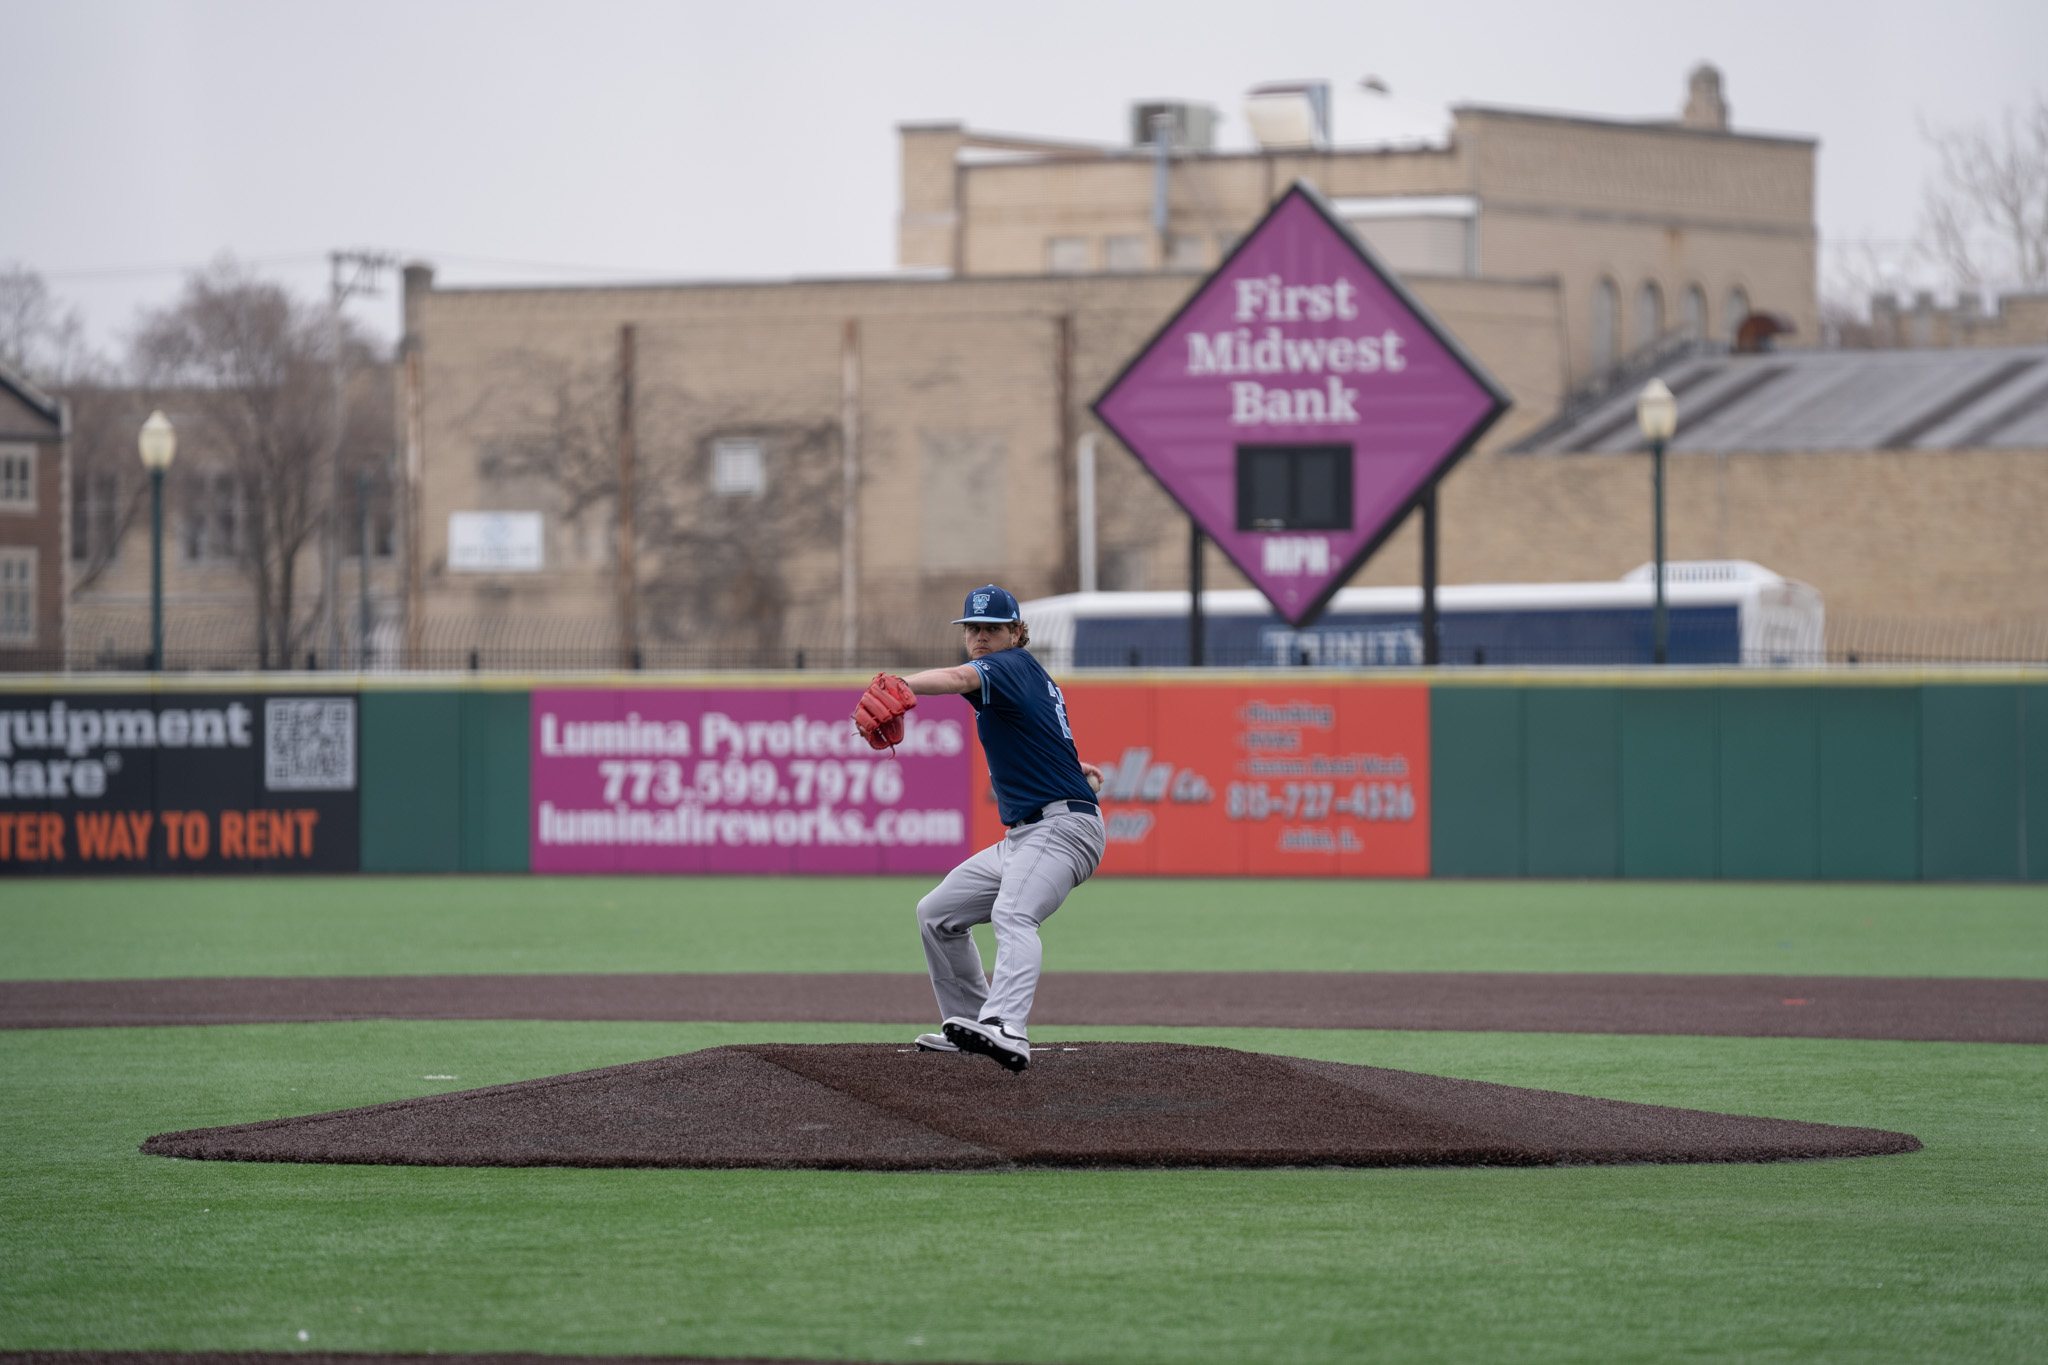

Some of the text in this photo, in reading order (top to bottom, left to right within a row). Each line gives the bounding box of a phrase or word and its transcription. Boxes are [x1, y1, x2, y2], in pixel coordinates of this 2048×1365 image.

[1233, 274, 1358, 322] First
[1185, 328, 1406, 375] Midwest
[1230, 377, 1360, 425] Bank
[1263, 535, 1330, 577] MPH
[540, 711, 964, 763] Lumina Pyrotecics
[599, 759, 904, 805] 773.599.7976
[75, 810, 154, 861] WAY
[160, 810, 210, 860] TO
[219, 808, 320, 859] RENT
[539, 799, 965, 847] luminafireworks.com
